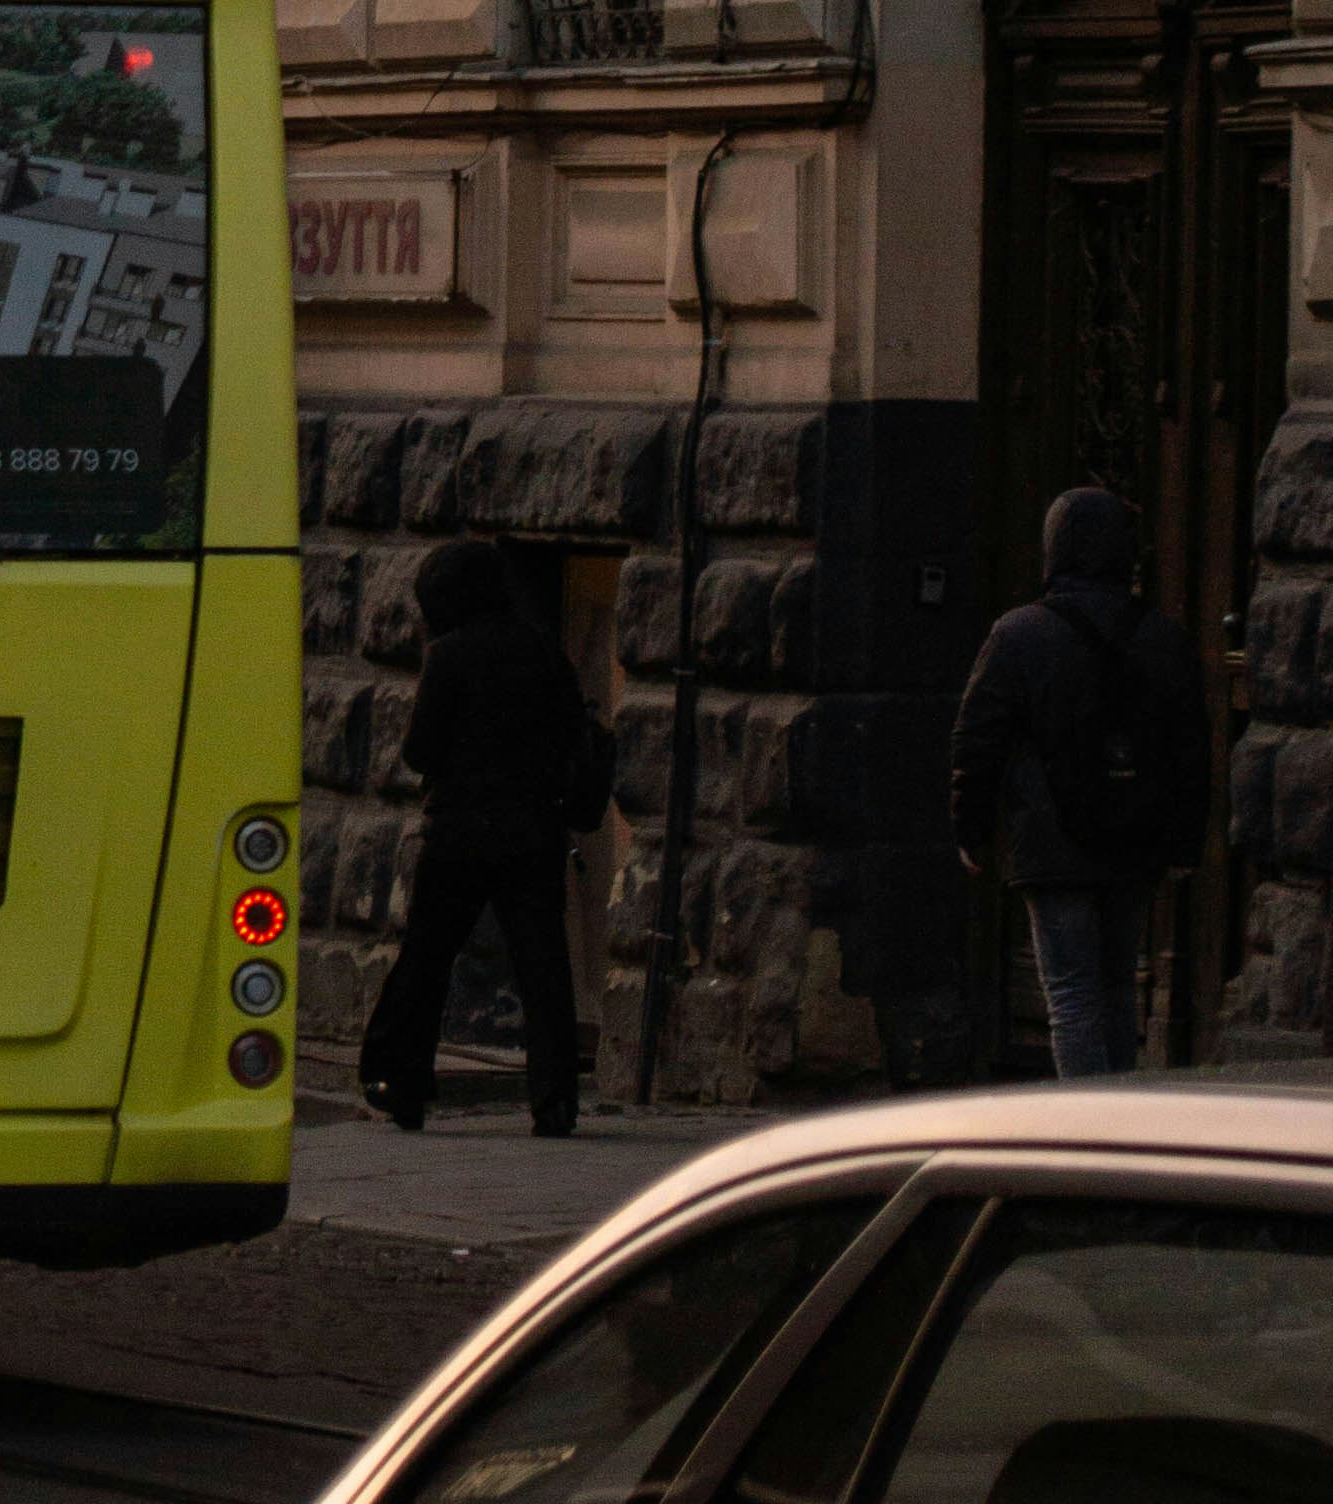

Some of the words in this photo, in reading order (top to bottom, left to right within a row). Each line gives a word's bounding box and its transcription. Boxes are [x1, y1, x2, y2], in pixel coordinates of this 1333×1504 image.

[9, 447, 61, 472] 888
[68, 447, 101, 472] 79
[107, 447, 141, 472] 79
